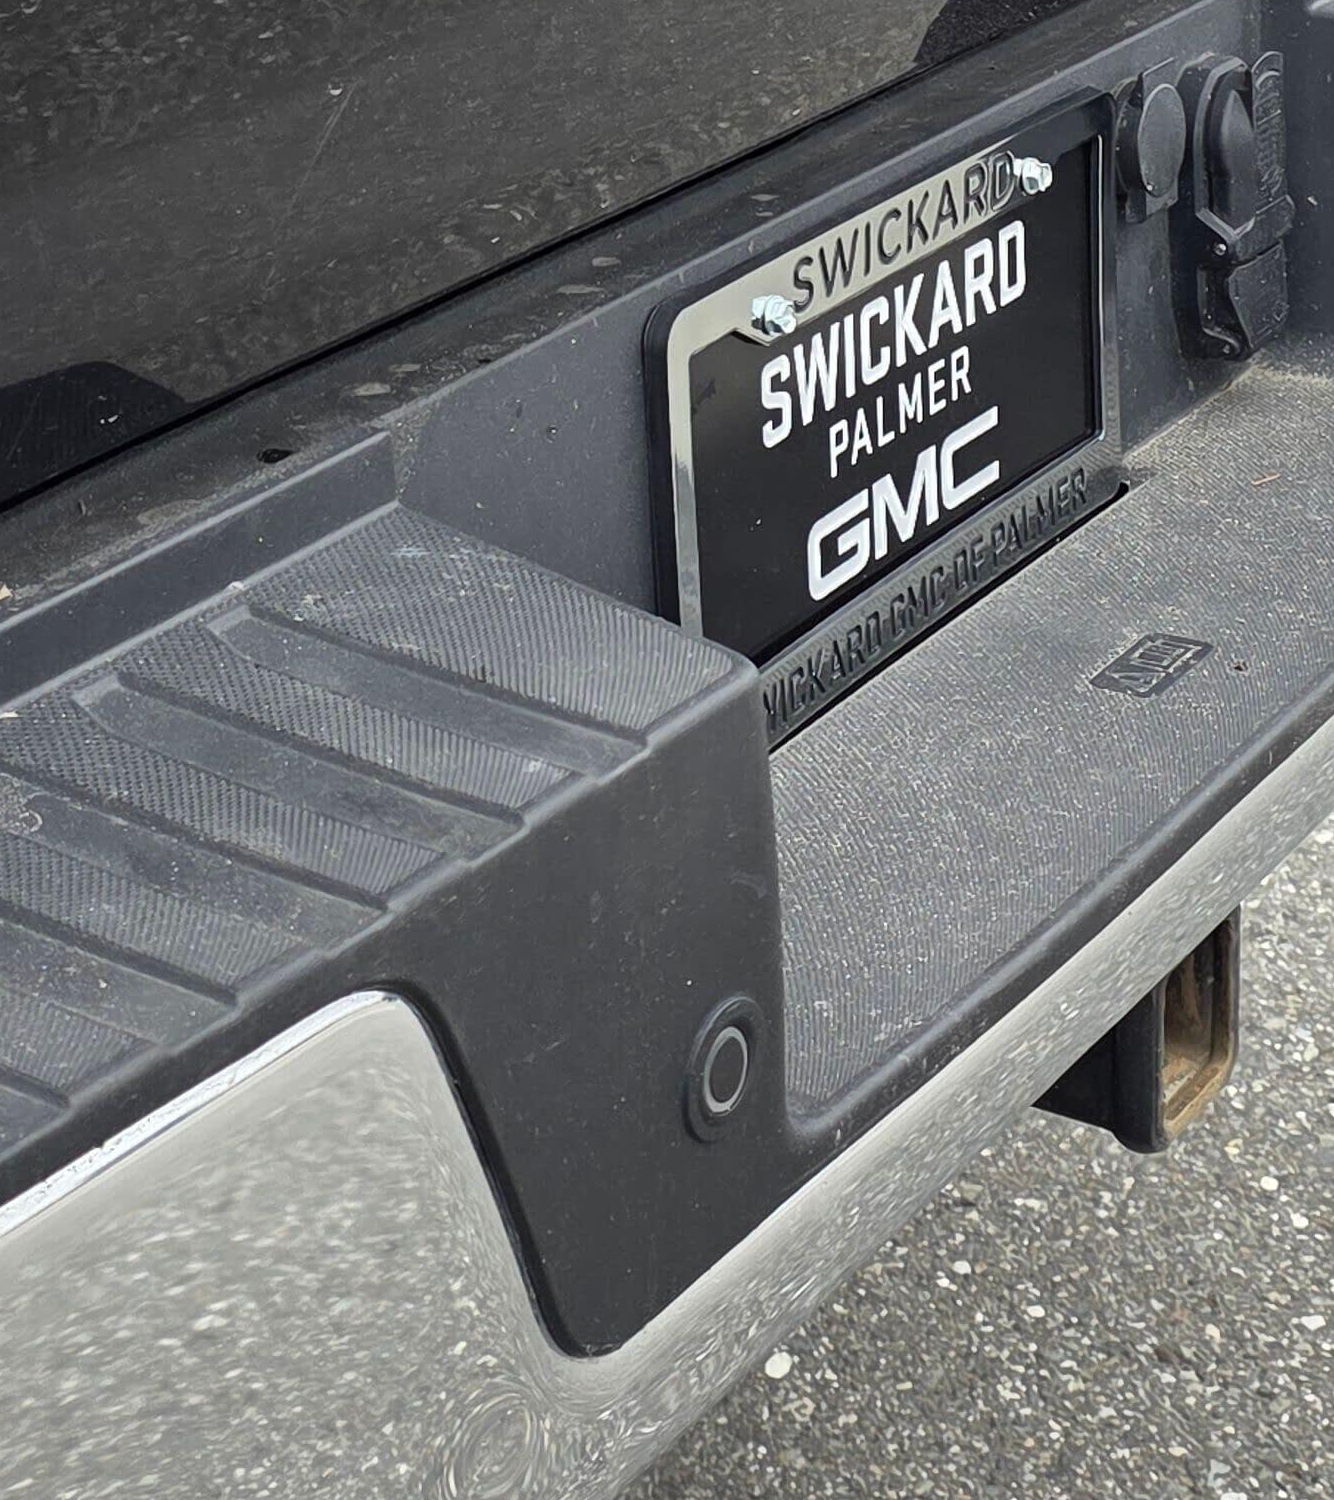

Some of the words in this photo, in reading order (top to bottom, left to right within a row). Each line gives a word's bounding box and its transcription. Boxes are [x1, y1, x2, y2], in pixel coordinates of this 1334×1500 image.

[793, 150, 1018, 314] SWICKARD
[761, 220, 1027, 449] SWICKARD
[829, 345, 971, 478] PALMER
[807, 406, 1000, 601] GMC
[890, 566, 946, 641] GMC
[954, 537, 985, 591] OF
[991, 467, 1088, 567] PALMER
